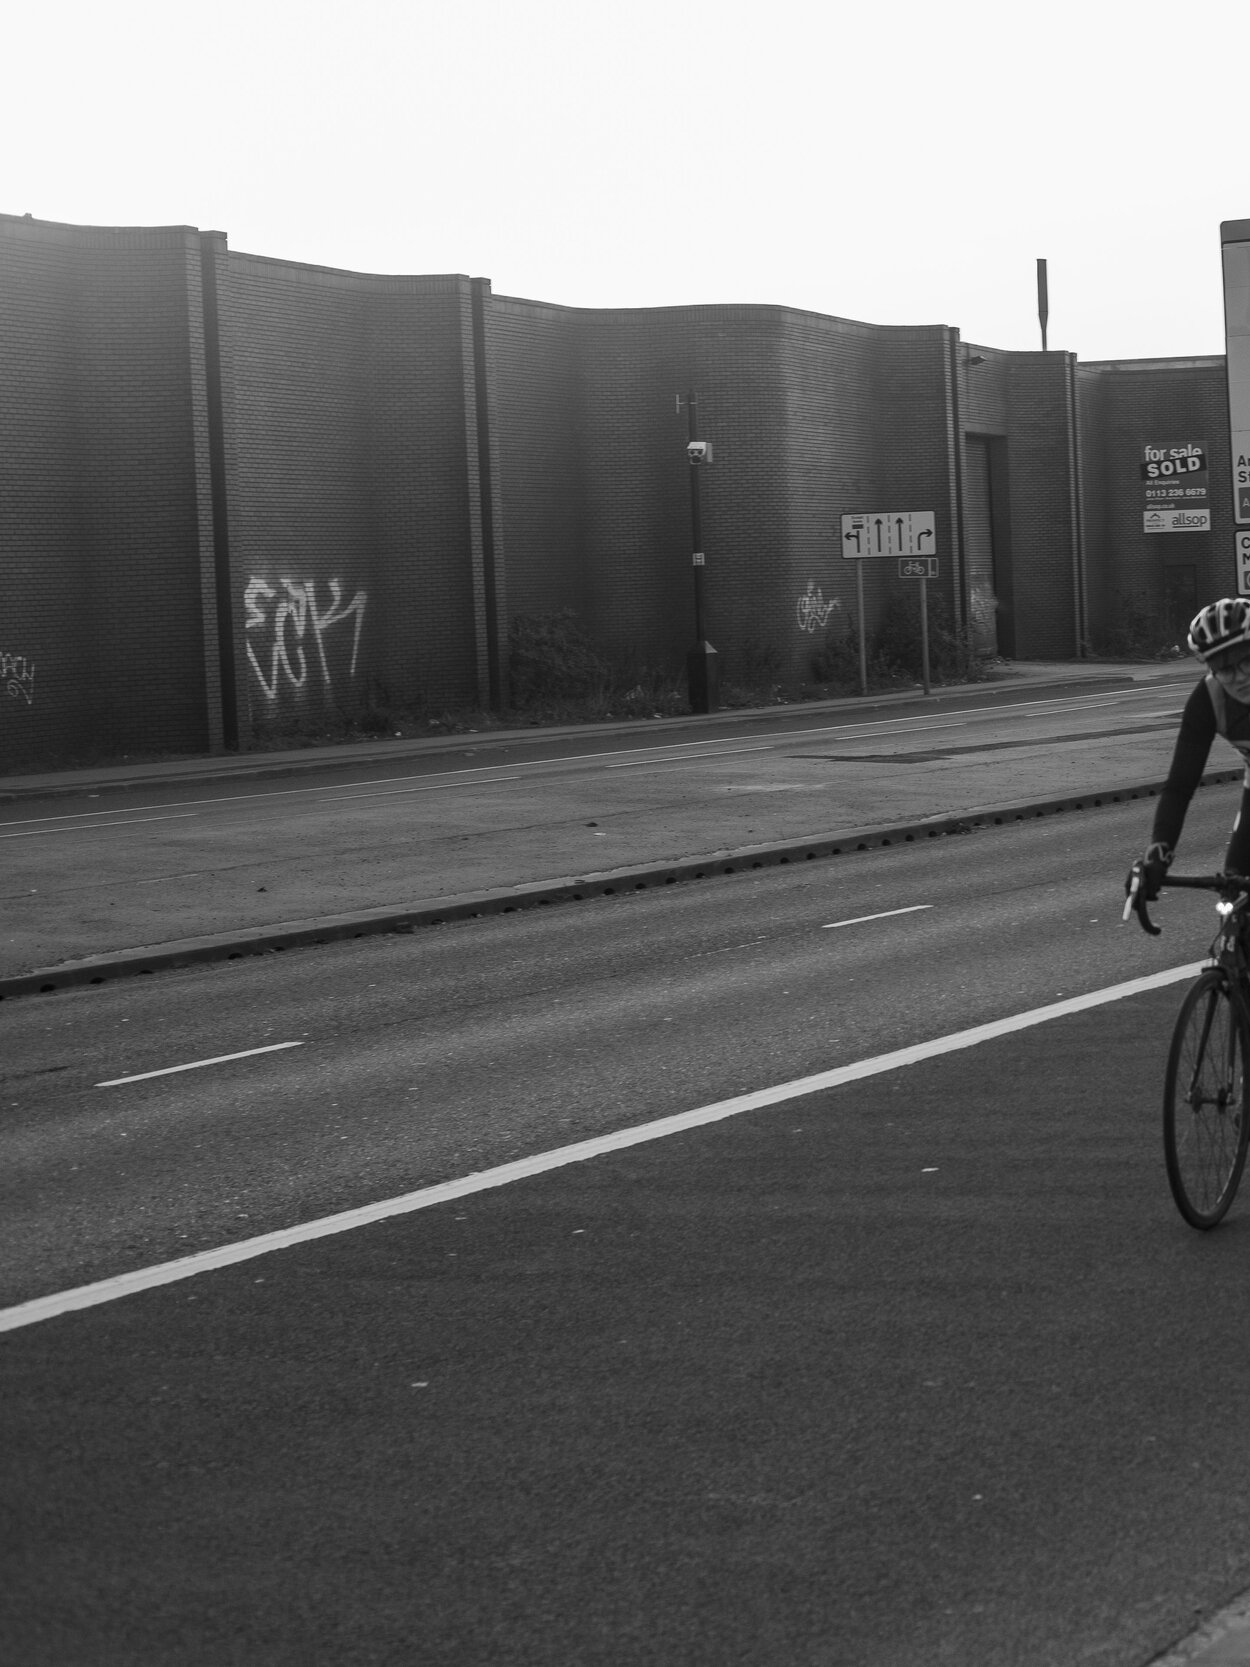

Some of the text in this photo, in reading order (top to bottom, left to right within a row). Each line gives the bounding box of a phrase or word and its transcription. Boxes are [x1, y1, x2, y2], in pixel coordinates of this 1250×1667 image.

[1144, 444, 1202, 461] for sale
[1147, 457, 1200, 478] SOLD
[1145, 489, 1167, 497] 0113
[1171, 513, 1207, 527] allsop
